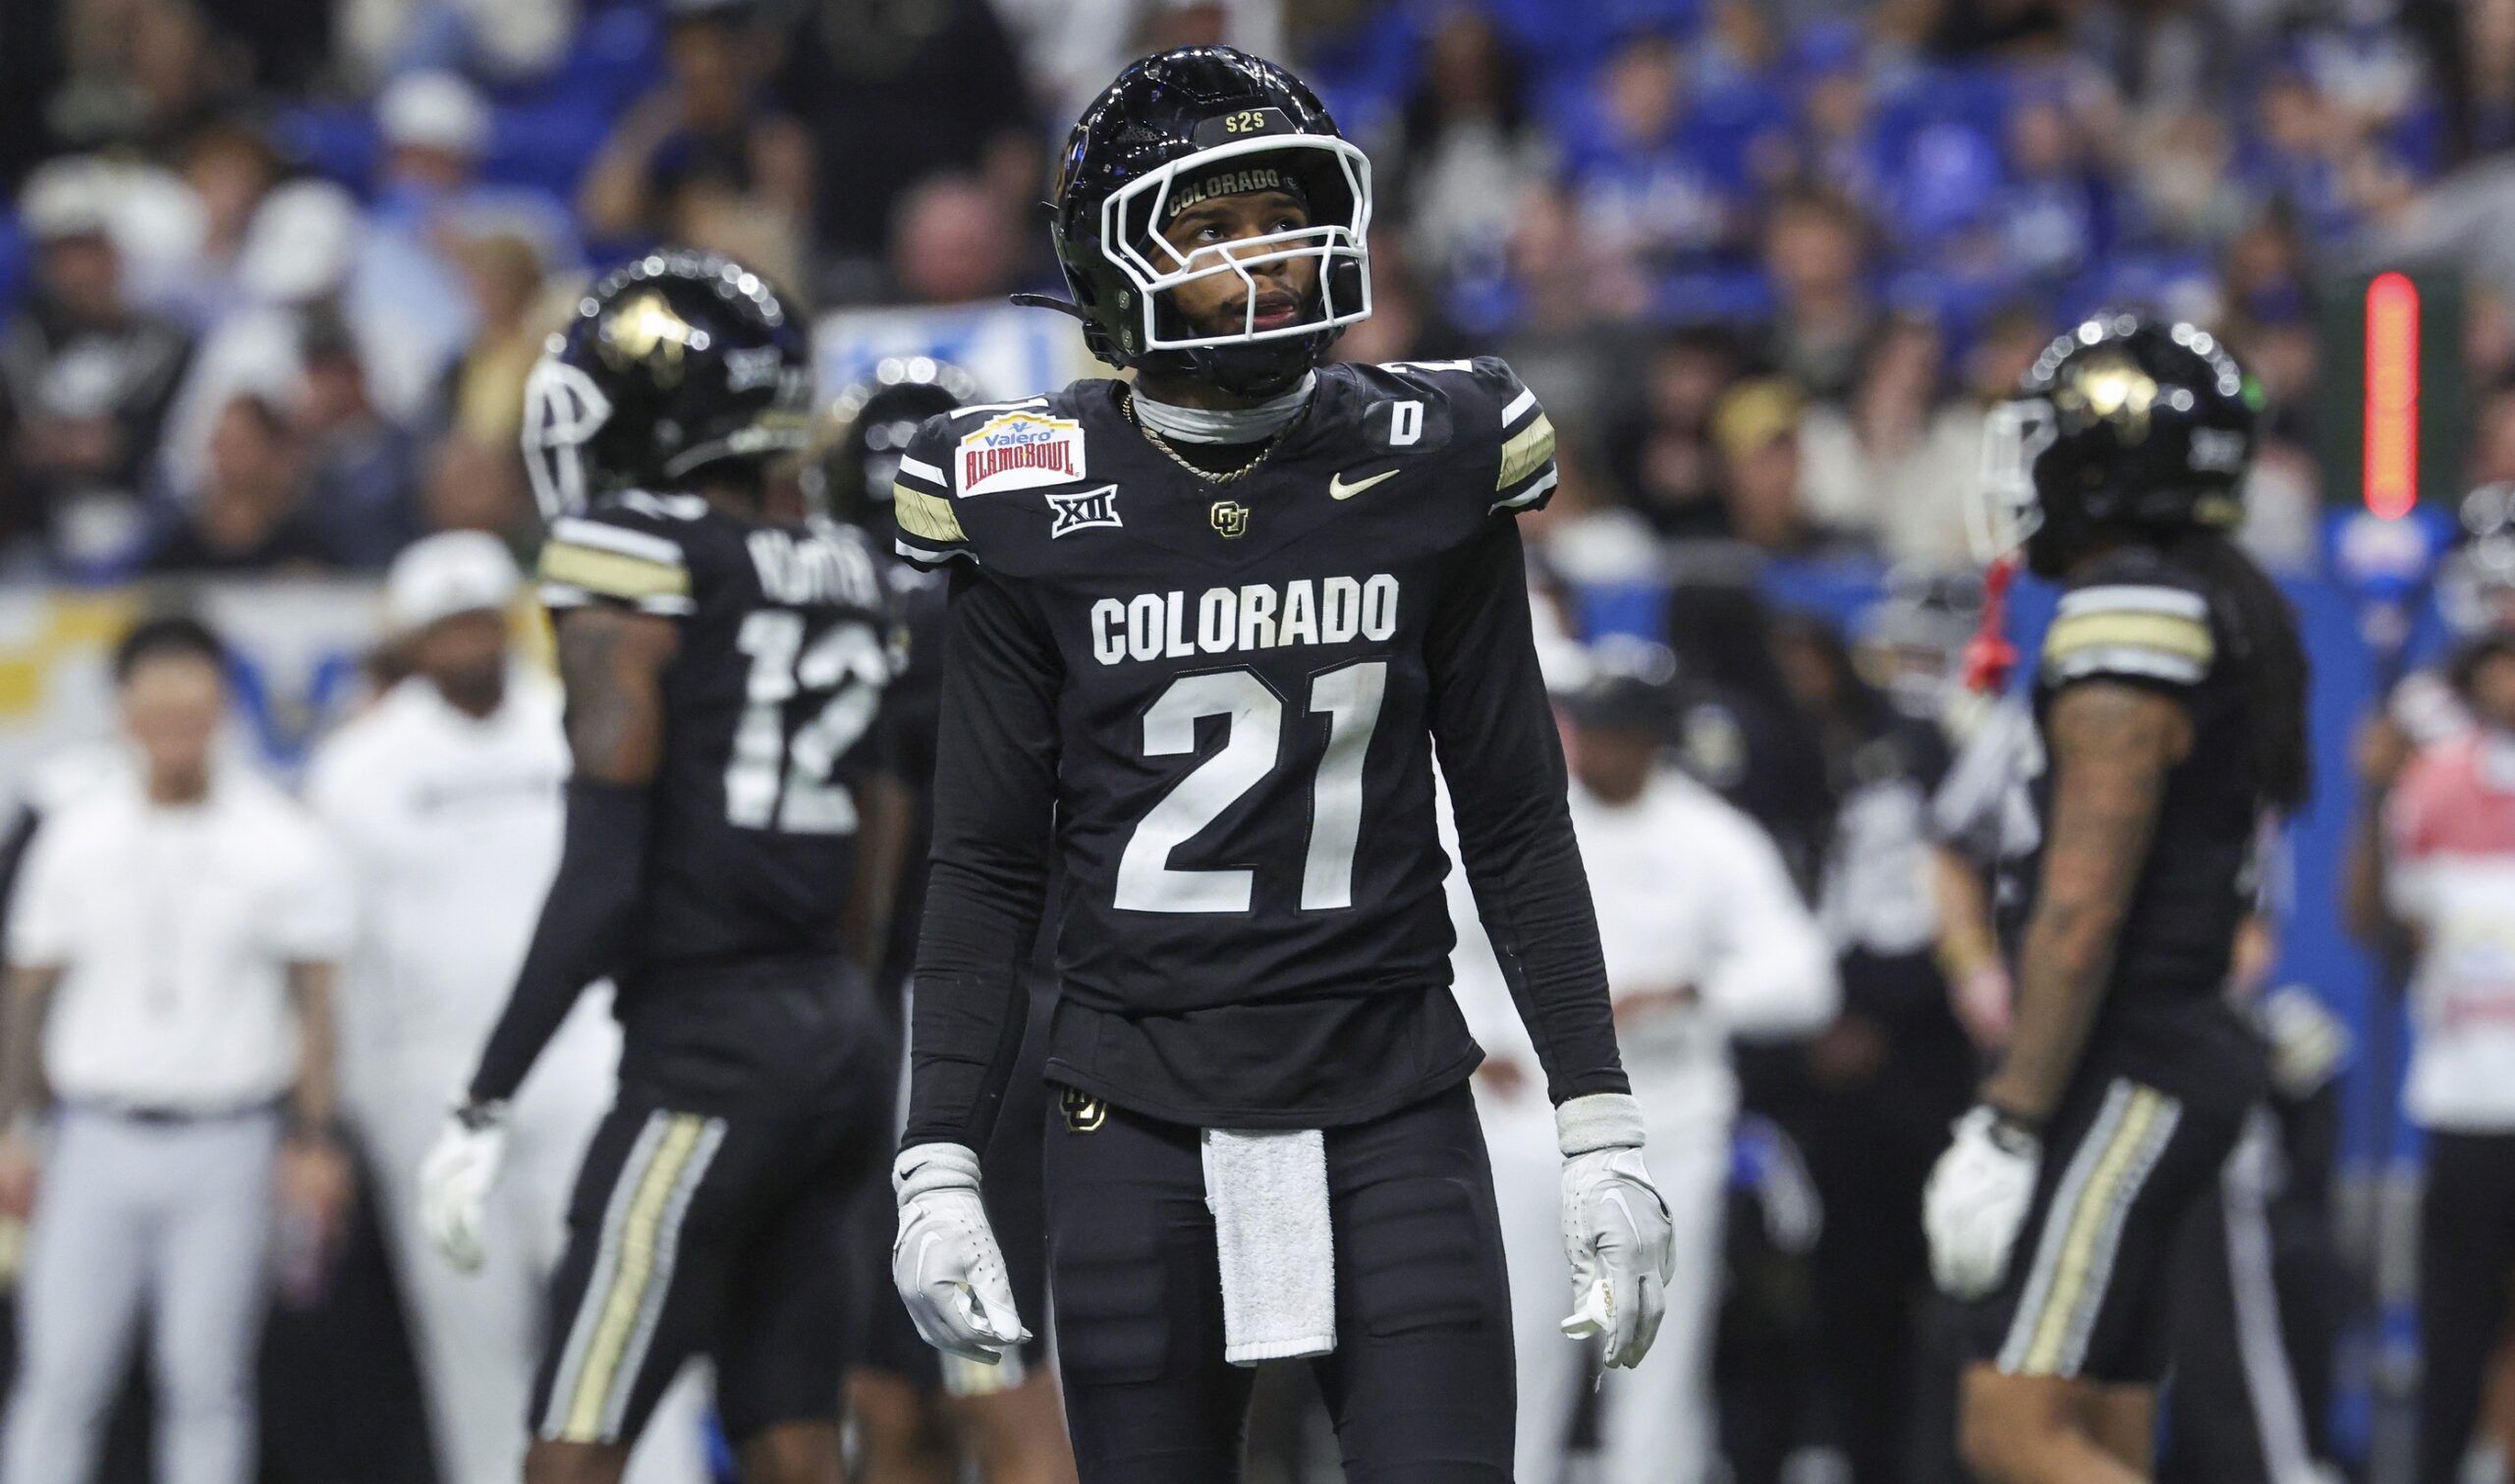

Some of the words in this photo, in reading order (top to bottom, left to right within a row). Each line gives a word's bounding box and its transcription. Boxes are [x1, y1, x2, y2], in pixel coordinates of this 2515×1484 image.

[1168, 169, 1281, 217] COLORADO
[984, 431, 1051, 448] Valero
[1389, 400, 1425, 446] D
[1090, 574, 1399, 666] COLORADO
[724, 609, 888, 834] 12
[1112, 661, 1387, 913] 21
